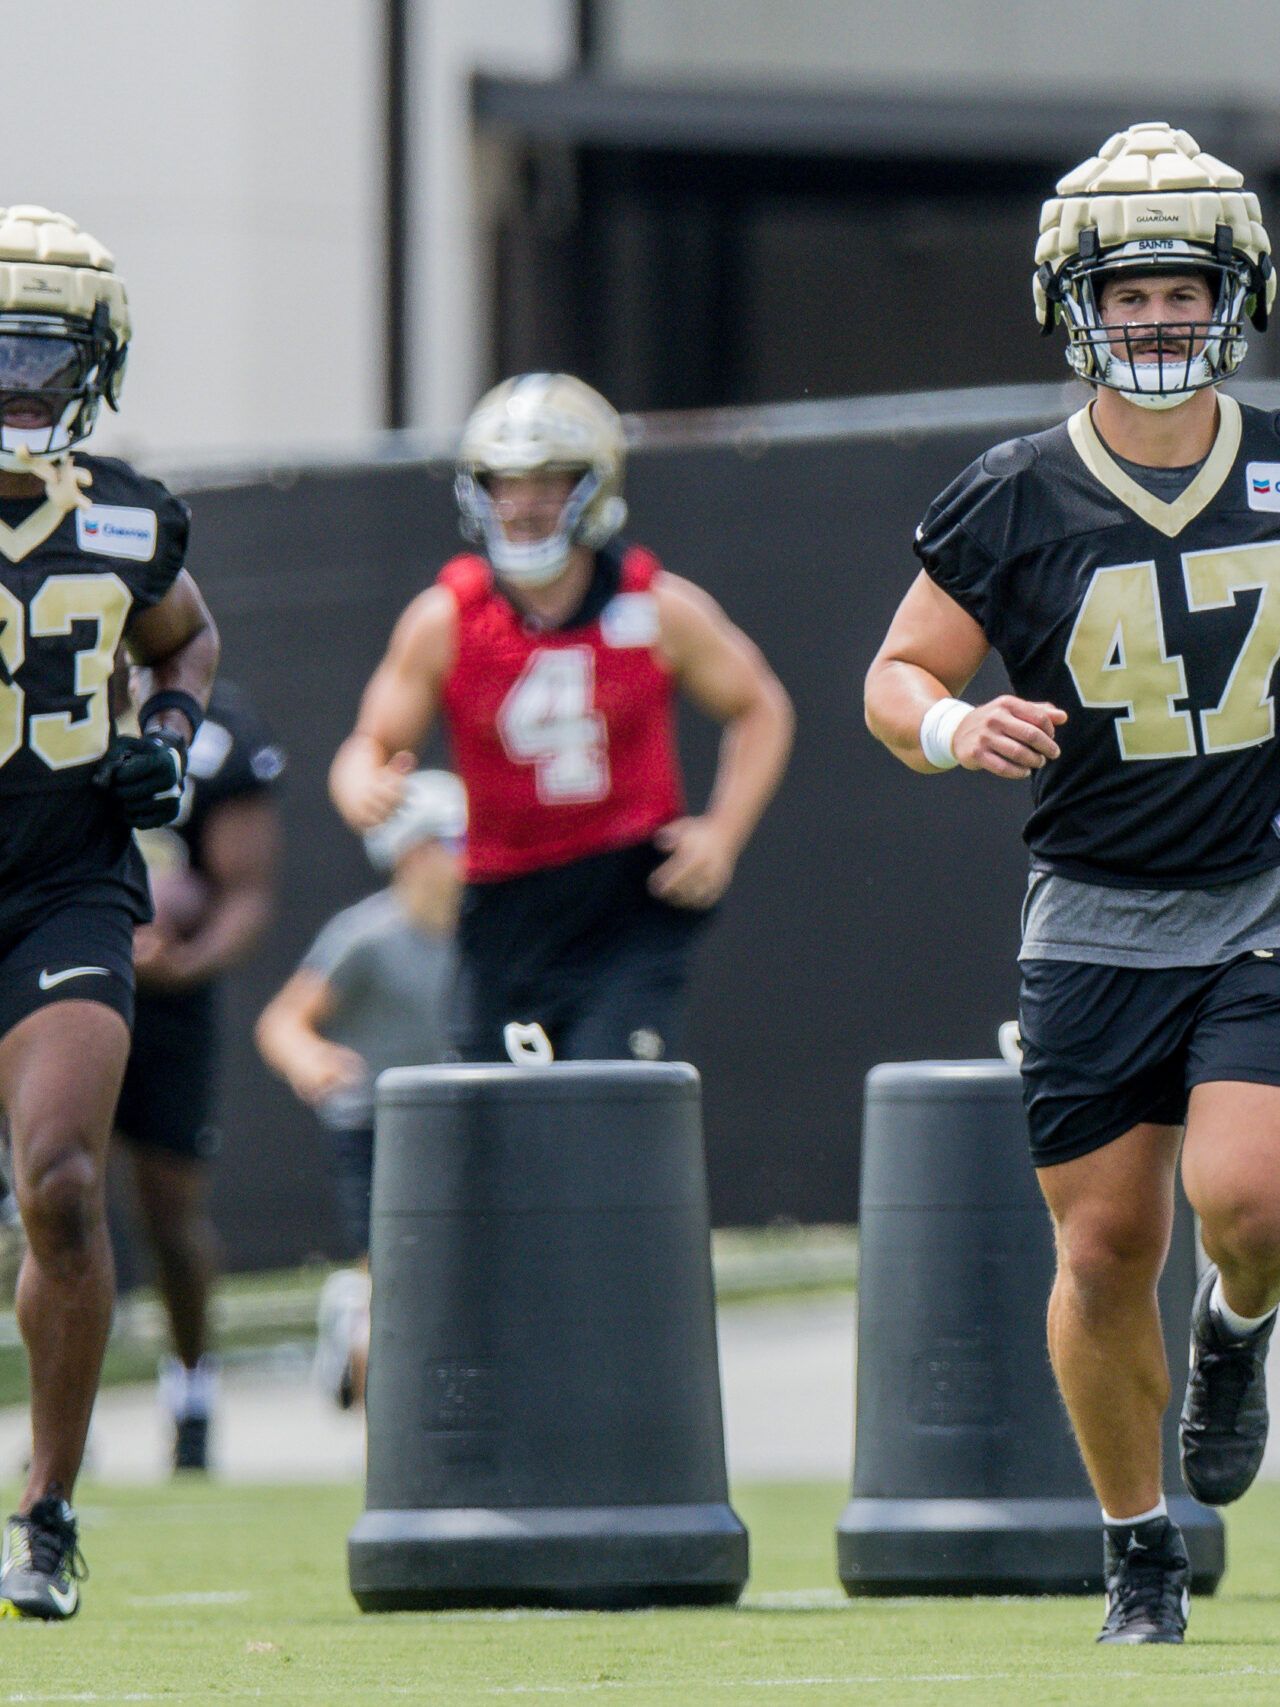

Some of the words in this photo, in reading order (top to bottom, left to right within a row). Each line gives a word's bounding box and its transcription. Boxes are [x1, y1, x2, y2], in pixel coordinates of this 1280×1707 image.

[1136, 215, 1179, 223] GUARDIAN
[1138, 240, 1174, 250] SAINTS
[496, 643, 612, 806] 4
